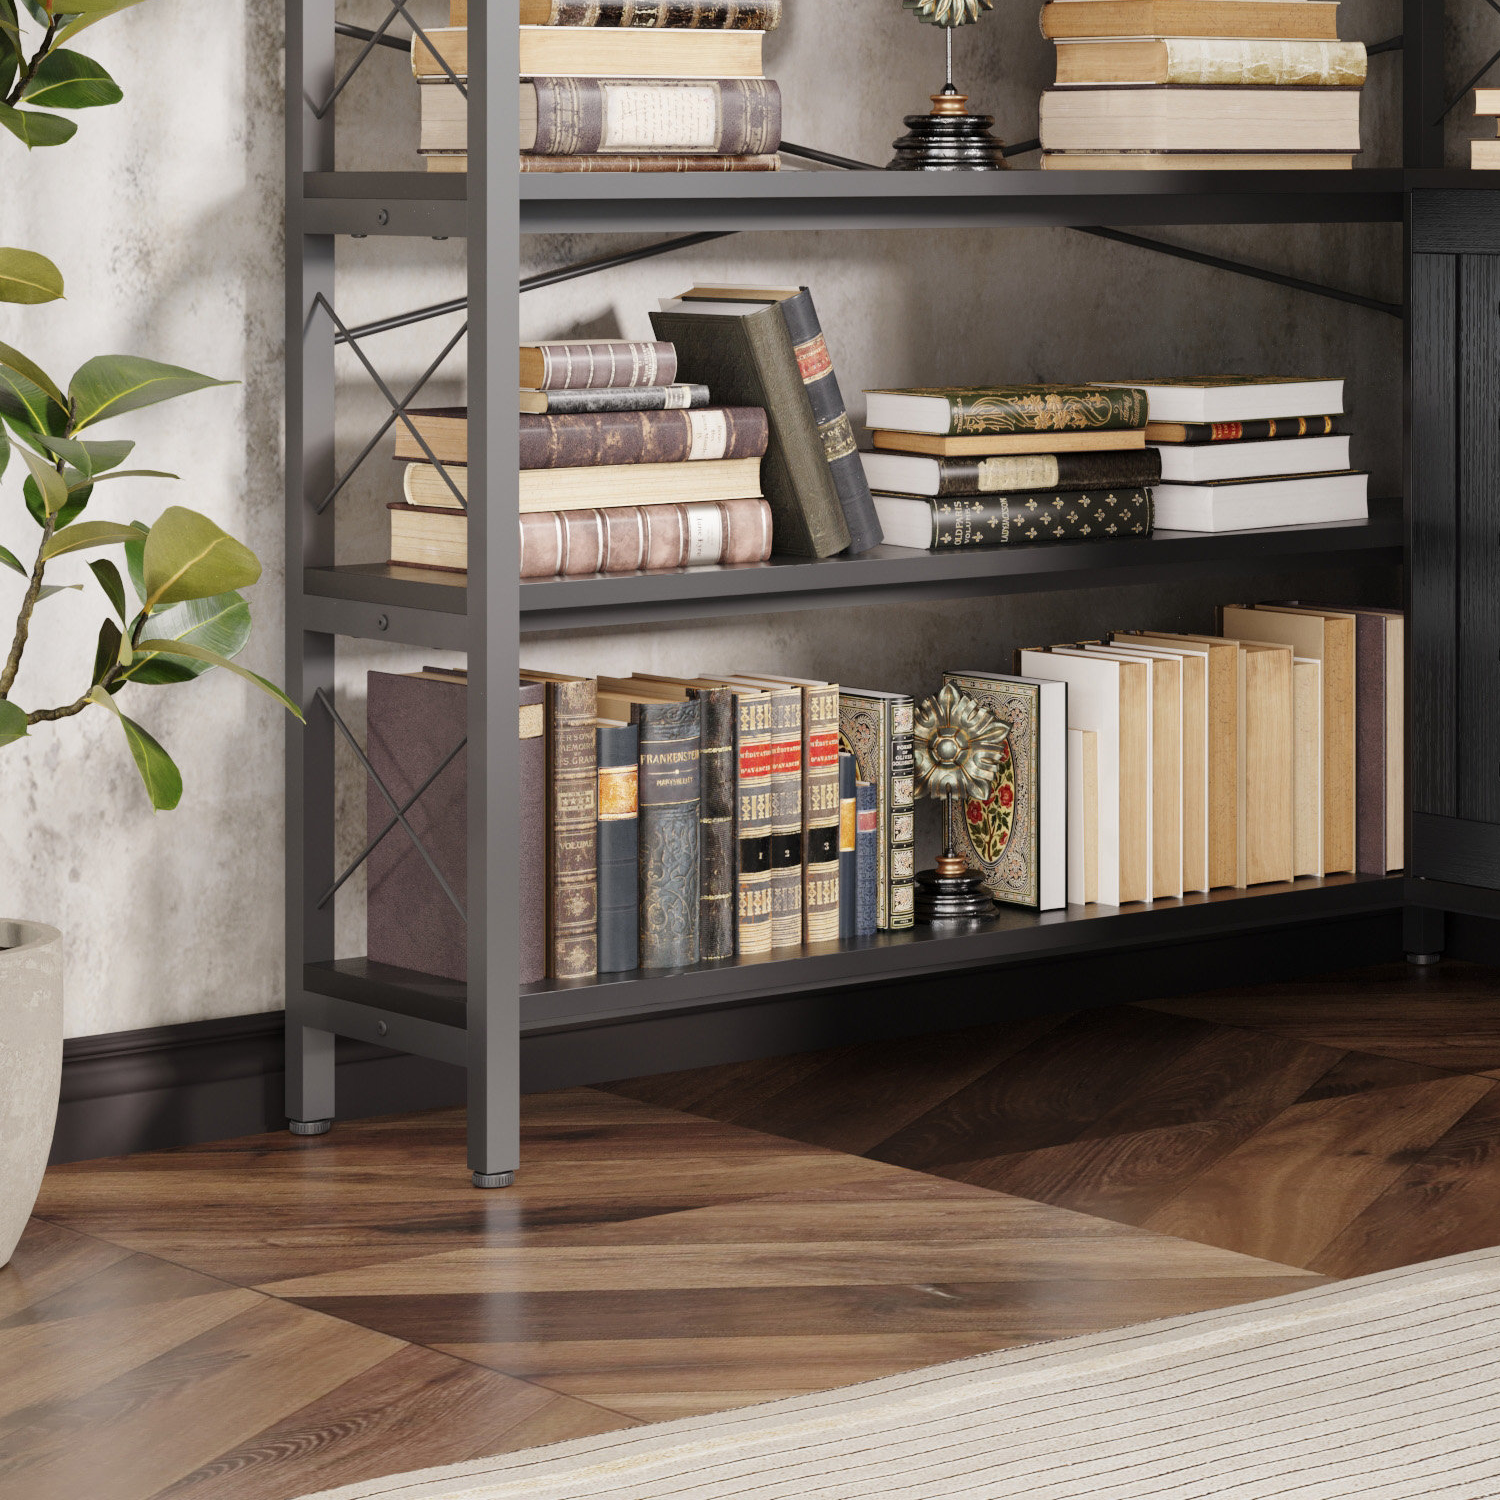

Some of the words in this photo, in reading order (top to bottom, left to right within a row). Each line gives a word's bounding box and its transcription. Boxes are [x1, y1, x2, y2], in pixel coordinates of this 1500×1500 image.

[953, 501, 963, 529] PARIS
[953, 529, 962, 546] OLD
[558, 838, 594, 850] VOLUME
[823, 841, 830, 851] 3
[784, 849, 790, 858] 2
